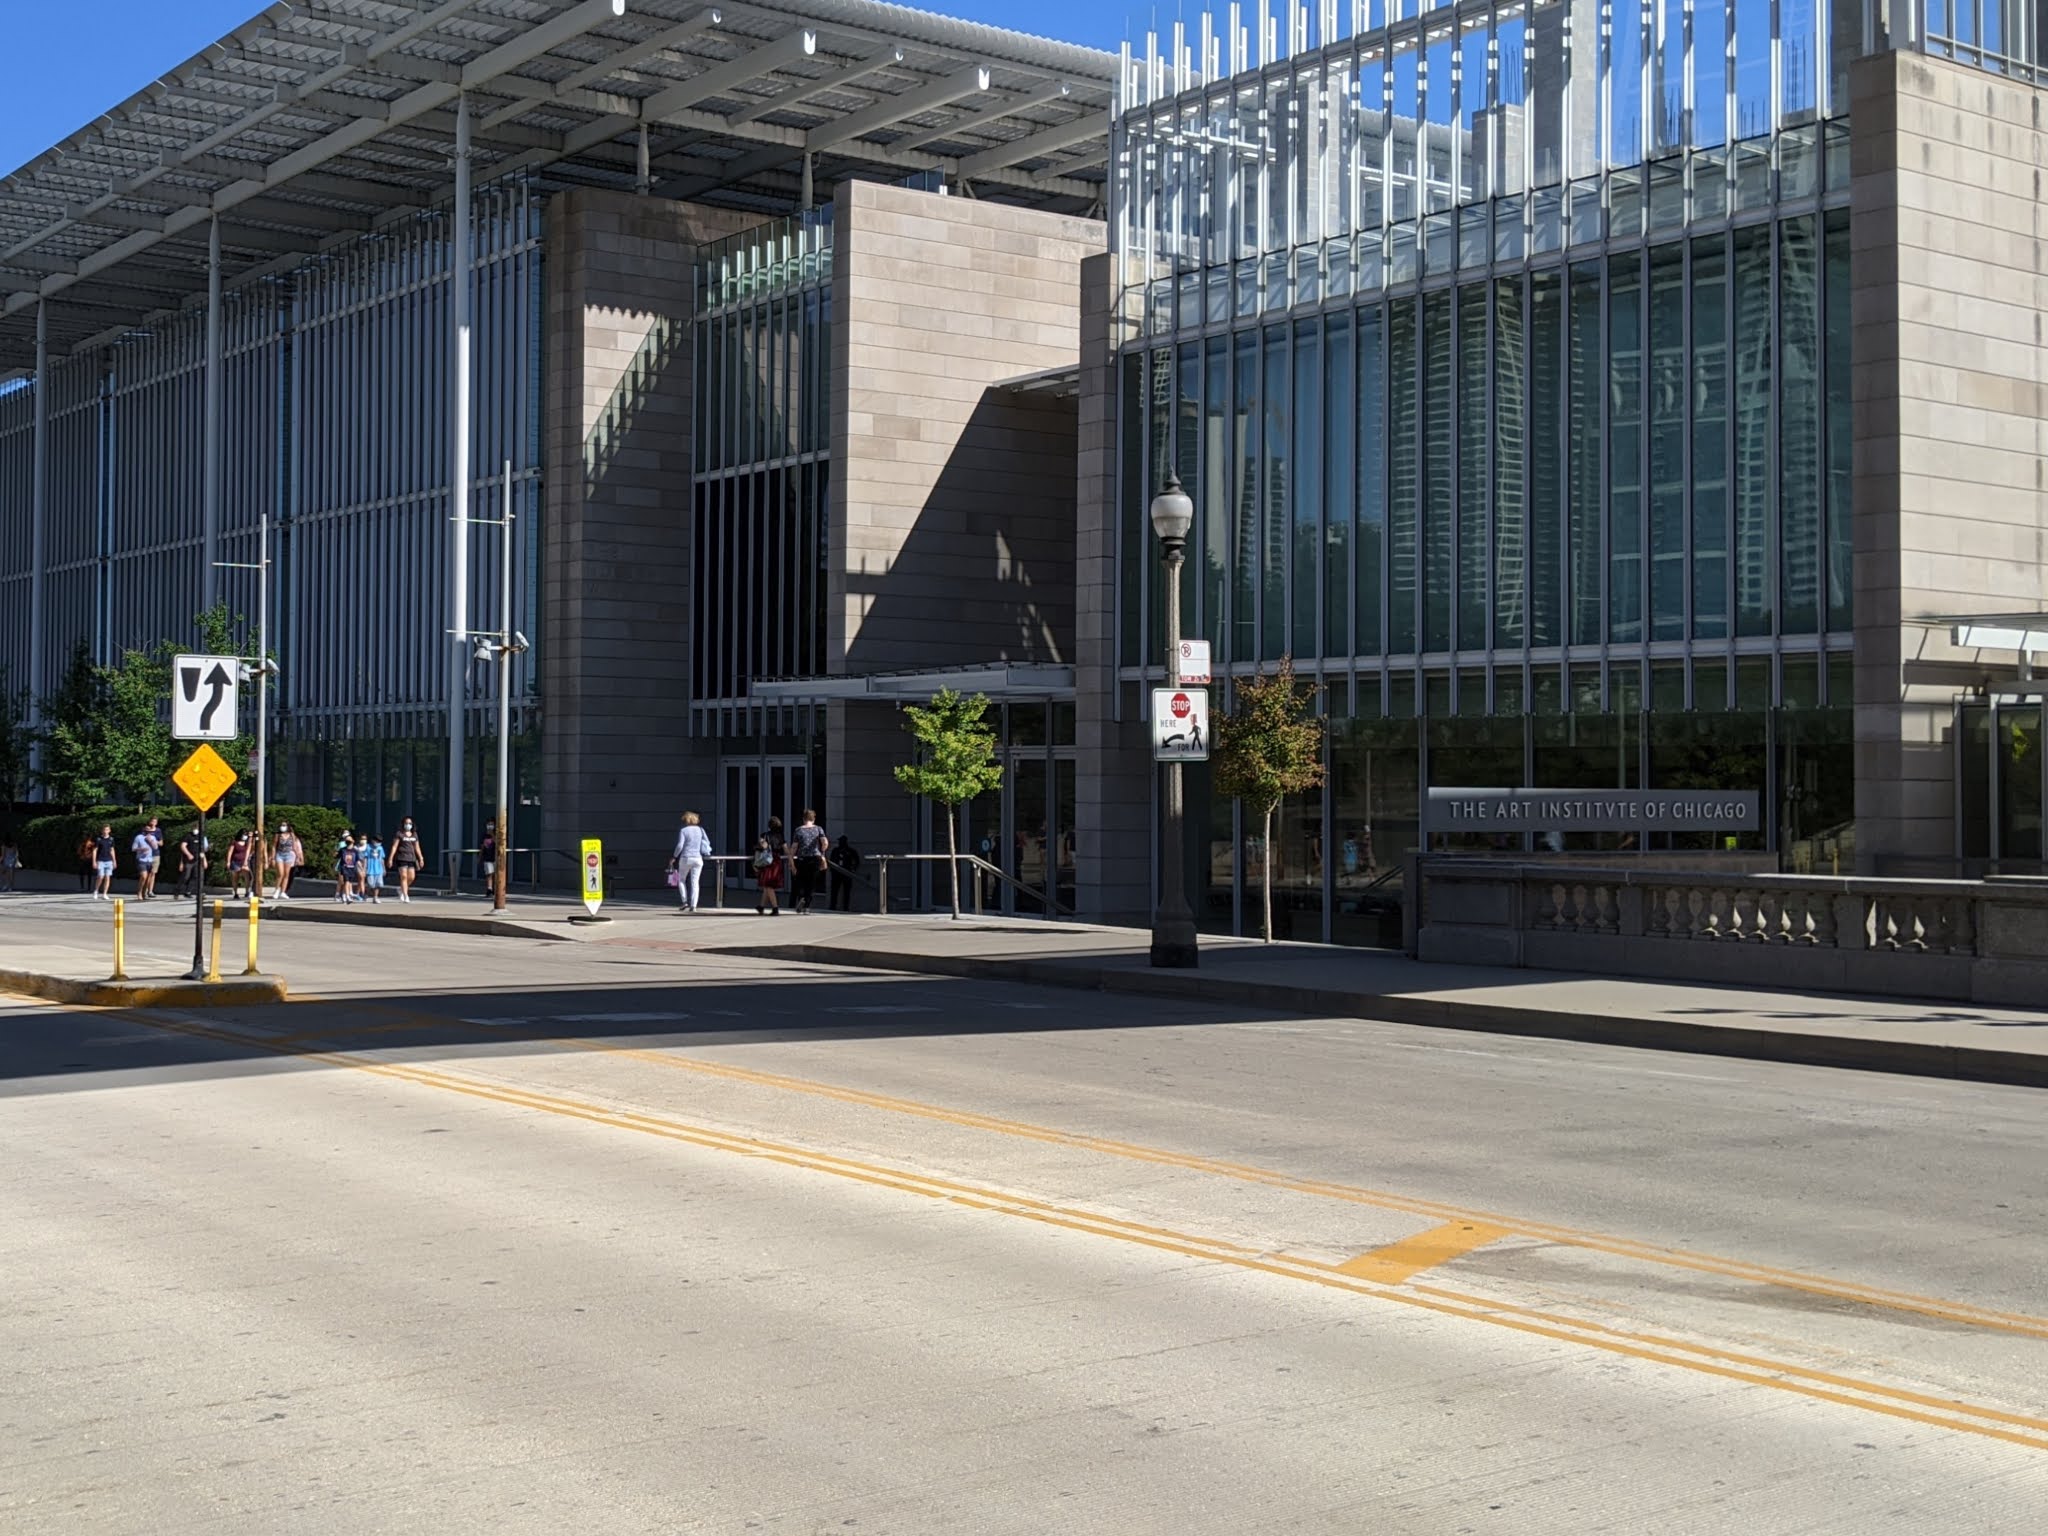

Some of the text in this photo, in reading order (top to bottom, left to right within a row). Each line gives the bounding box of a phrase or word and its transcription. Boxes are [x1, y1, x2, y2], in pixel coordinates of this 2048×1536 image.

[1171, 700, 1190, 711] STOP
[1160, 719, 1177, 728] HERE
[1177, 743, 1190, 752] FOR
[1450, 801, 1486, 818] THE
[1496, 801, 1531, 818] ART
[1645, 802, 1666, 818] OF
[1672, 802, 1746, 819] CHICAGO
